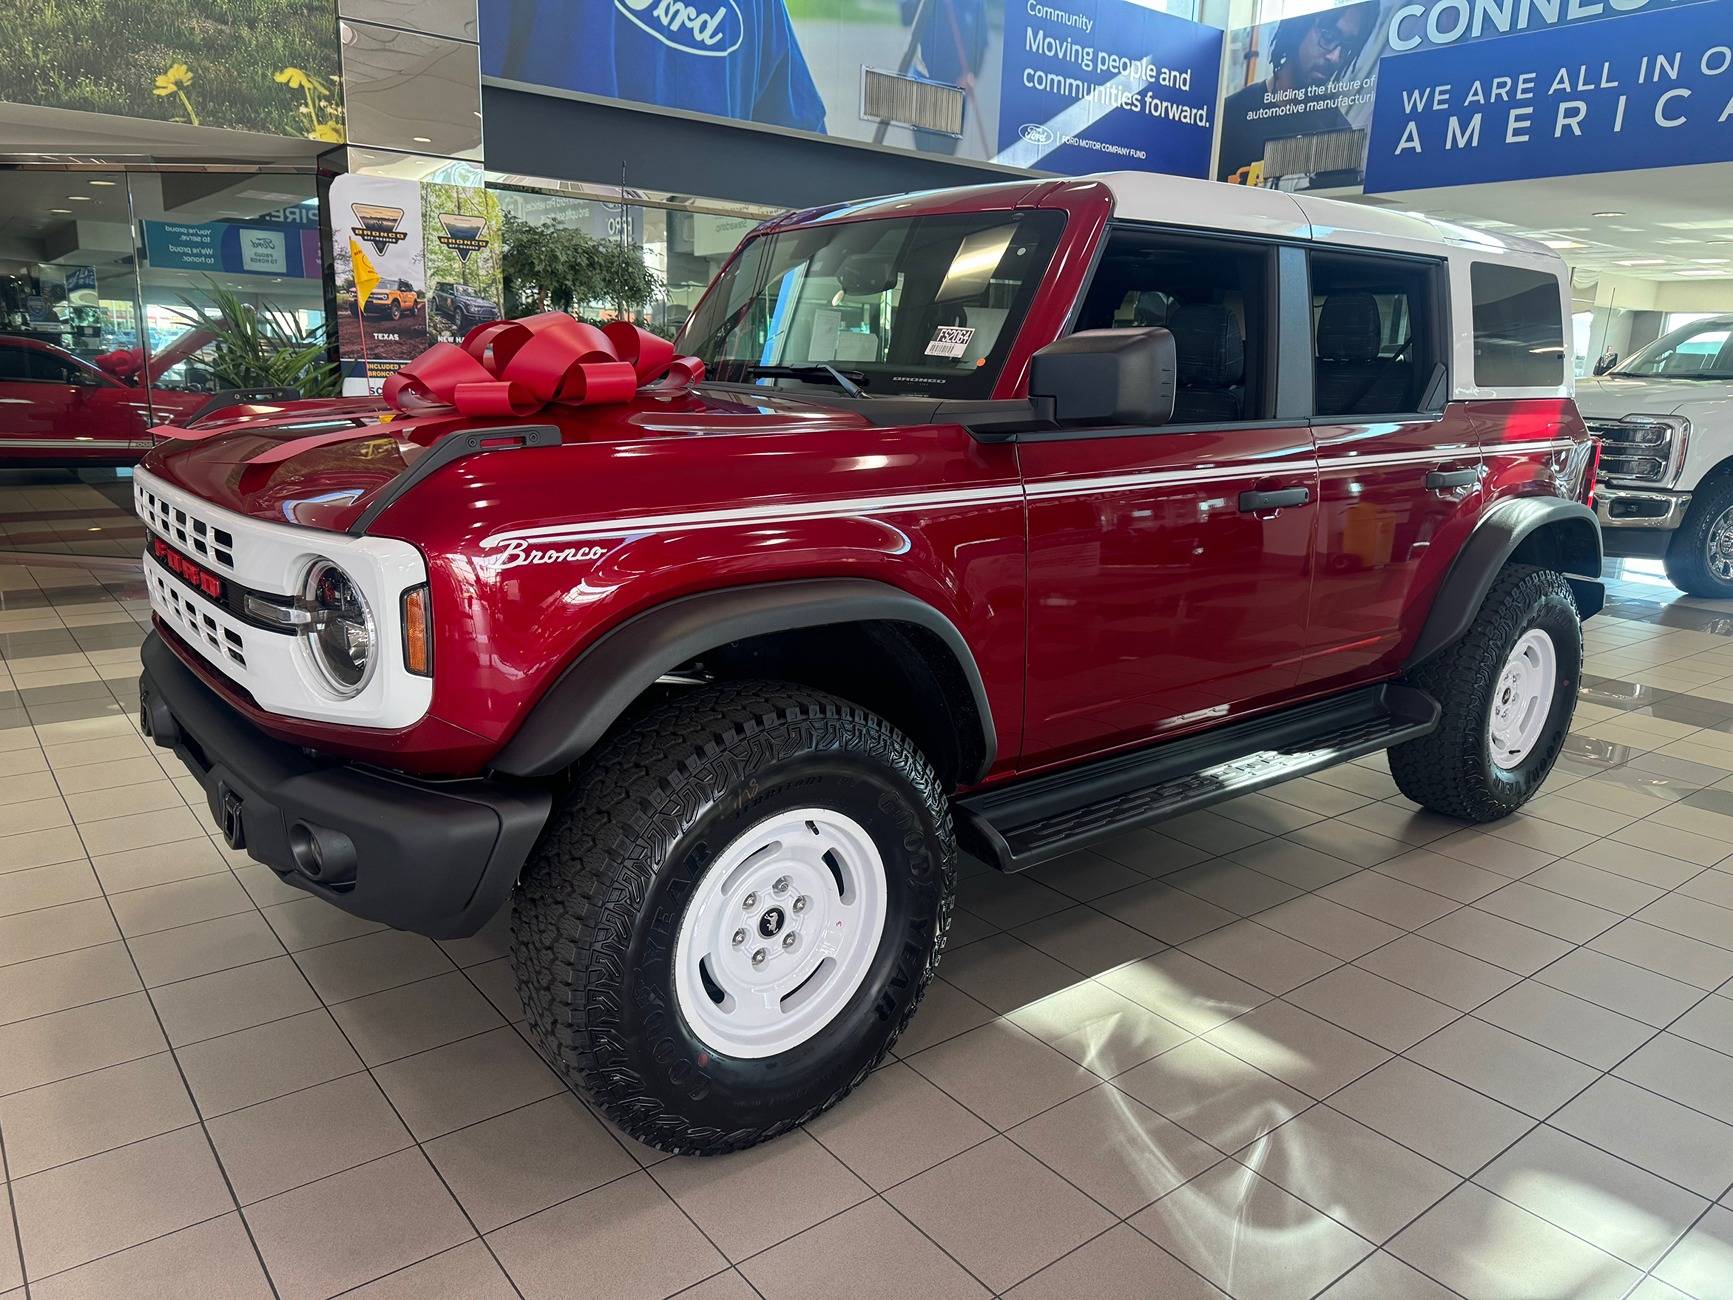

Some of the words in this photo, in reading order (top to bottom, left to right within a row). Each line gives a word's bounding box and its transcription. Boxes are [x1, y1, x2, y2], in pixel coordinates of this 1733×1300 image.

[1027, 0, 1094, 33] Community
[1388, 0, 1679, 52] CONN
[1025, 27, 1094, 71] Moving
[1097, 51, 1156, 83] people
[1159, 69, 1191, 92] and
[1263, 88, 1305, 104] Building
[1307, 85, 1325, 97] the
[1327, 80, 1361, 93] future
[1362, 75, 1377, 88] of
[1402, 84, 1451, 114] WE
[1463, 72, 1537, 106] ARE
[1547, 61, 1619, 96] ALL
[1638, 51, 1682, 84] IN
[1700, 46, 1733, 76] O
[1023, 68, 1141, 112] communities
[1144, 91, 1210, 128] forward.
[1246, 103, 1305, 120] automotive
[1306, 90, 1377, 112] manufacturi
[1024, 126, 1048, 142] Ford
[1062, 136, 1079, 146] FORD
[1080, 139, 1101, 151] MOTOR
[1101, 143, 1130, 156] COMPANY
[1130, 149, 1146, 159] FUND
[355, 229, 404, 239] BRONCO
[440, 238, 486, 246] BRONCO
[373, 333, 399, 341] TEXAS
[154, 537, 222, 598] FORD
[487, 539, 608, 570] Bronco
